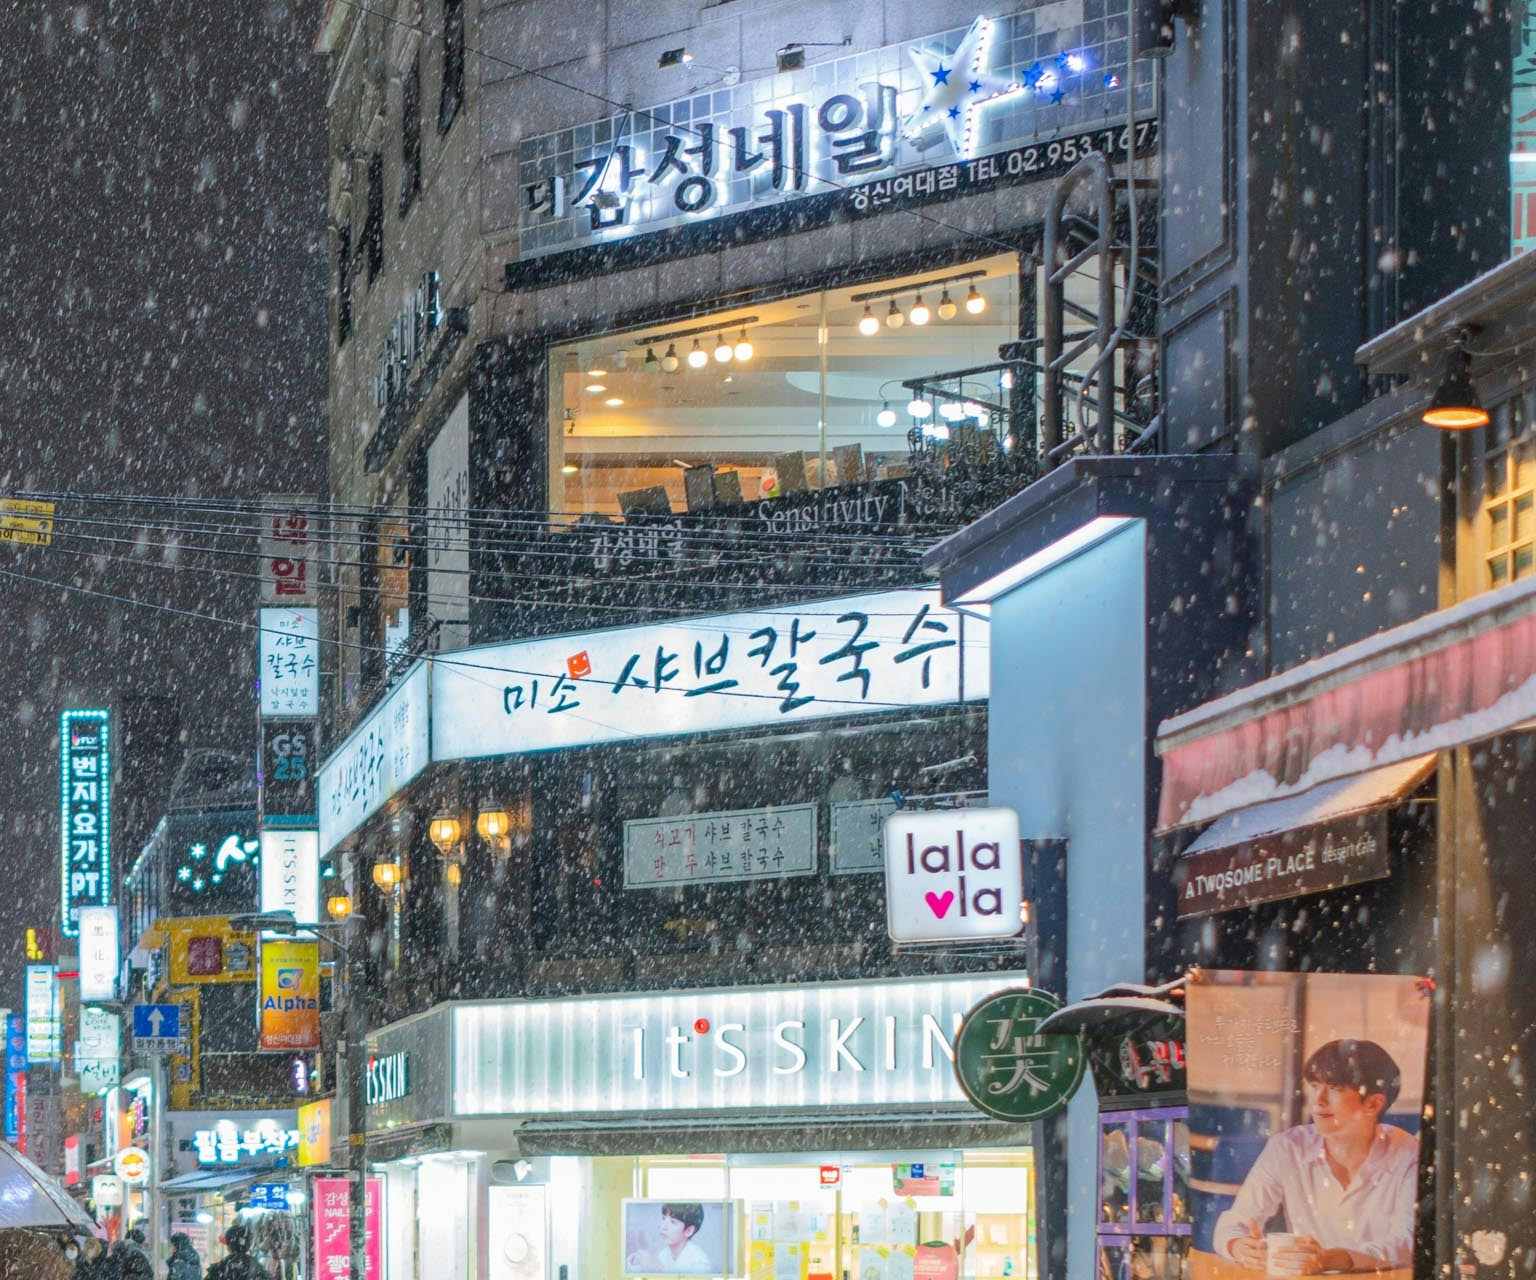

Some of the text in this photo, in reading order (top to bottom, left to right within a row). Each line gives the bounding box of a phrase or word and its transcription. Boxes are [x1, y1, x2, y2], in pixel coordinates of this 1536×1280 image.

[572, 81, 900, 229] 감성네일
[850, 167, 960, 209] 성신여대점
[967, 157, 1002, 185] TEL
[757, 492, 889, 534] Sensitivity
[267, 653, 316, 680] 칼국수
[504, 675, 581, 717] 미소
[271, 734, 307, 756] GS
[272, 757, 307, 781] 25
[703, 821, 733, 841] 샤브
[703, 851, 733, 870] 샤브
[906, 830, 1002, 874] lala
[1195, 862, 1263, 897] TWOSOME
[1266, 850, 1316, 879] PLACE
[958, 877, 1004, 918] la
[263, 995, 318, 1012] Alpha
[324, 1207, 373, 1218] NAIL SP
